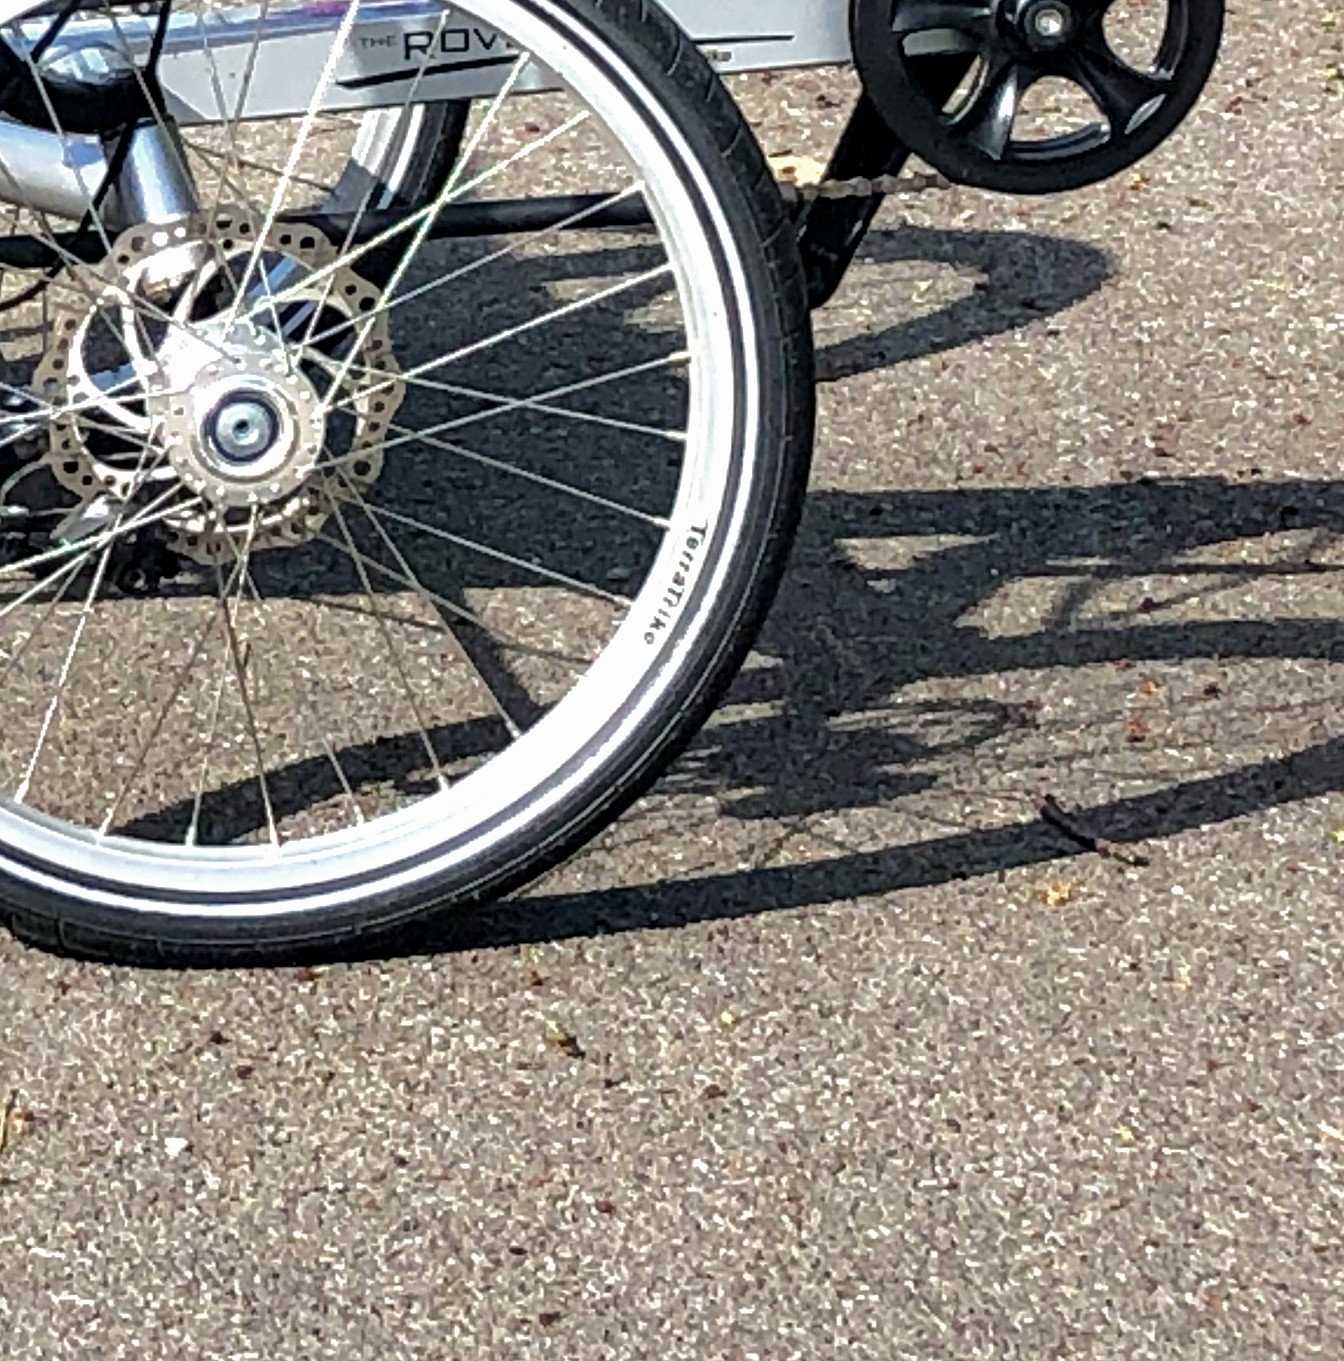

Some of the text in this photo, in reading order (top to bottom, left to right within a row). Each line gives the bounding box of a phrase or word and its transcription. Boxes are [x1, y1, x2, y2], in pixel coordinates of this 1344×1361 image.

[359, 27, 515, 61] THE ROV
[643, 518, 709, 646] TerraTrike
